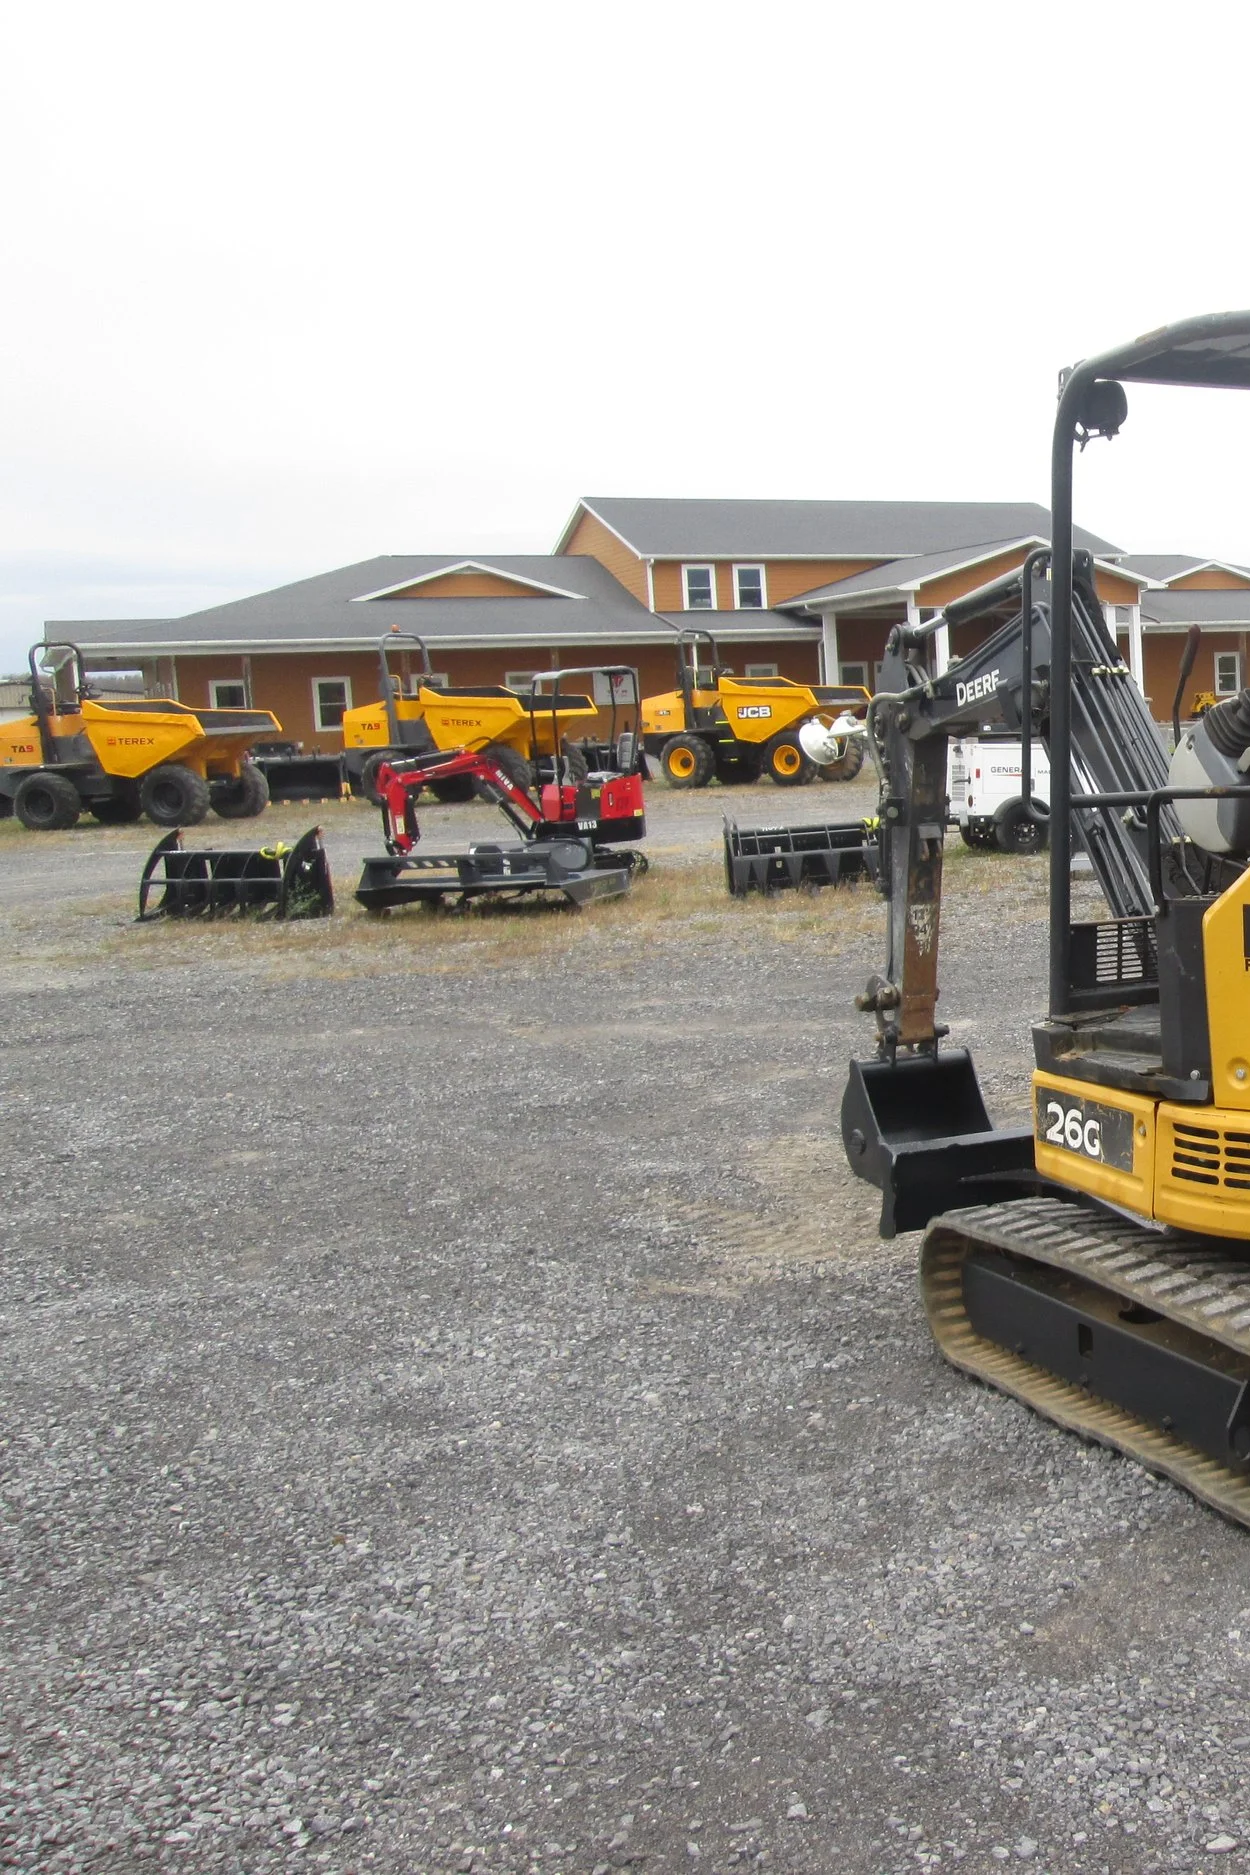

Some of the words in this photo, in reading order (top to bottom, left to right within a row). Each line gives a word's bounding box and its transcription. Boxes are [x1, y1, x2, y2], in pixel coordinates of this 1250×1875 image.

[738, 706, 771, 718] JCB
[361, 723, 381, 731] TA9
[451, 719, 482, 727] TEREX
[11, 745, 34, 753] TA9
[990, 766, 1023, 774] GENER
[577, 820, 597, 831] VA13
[1046, 1101, 1101, 1156] 26G
